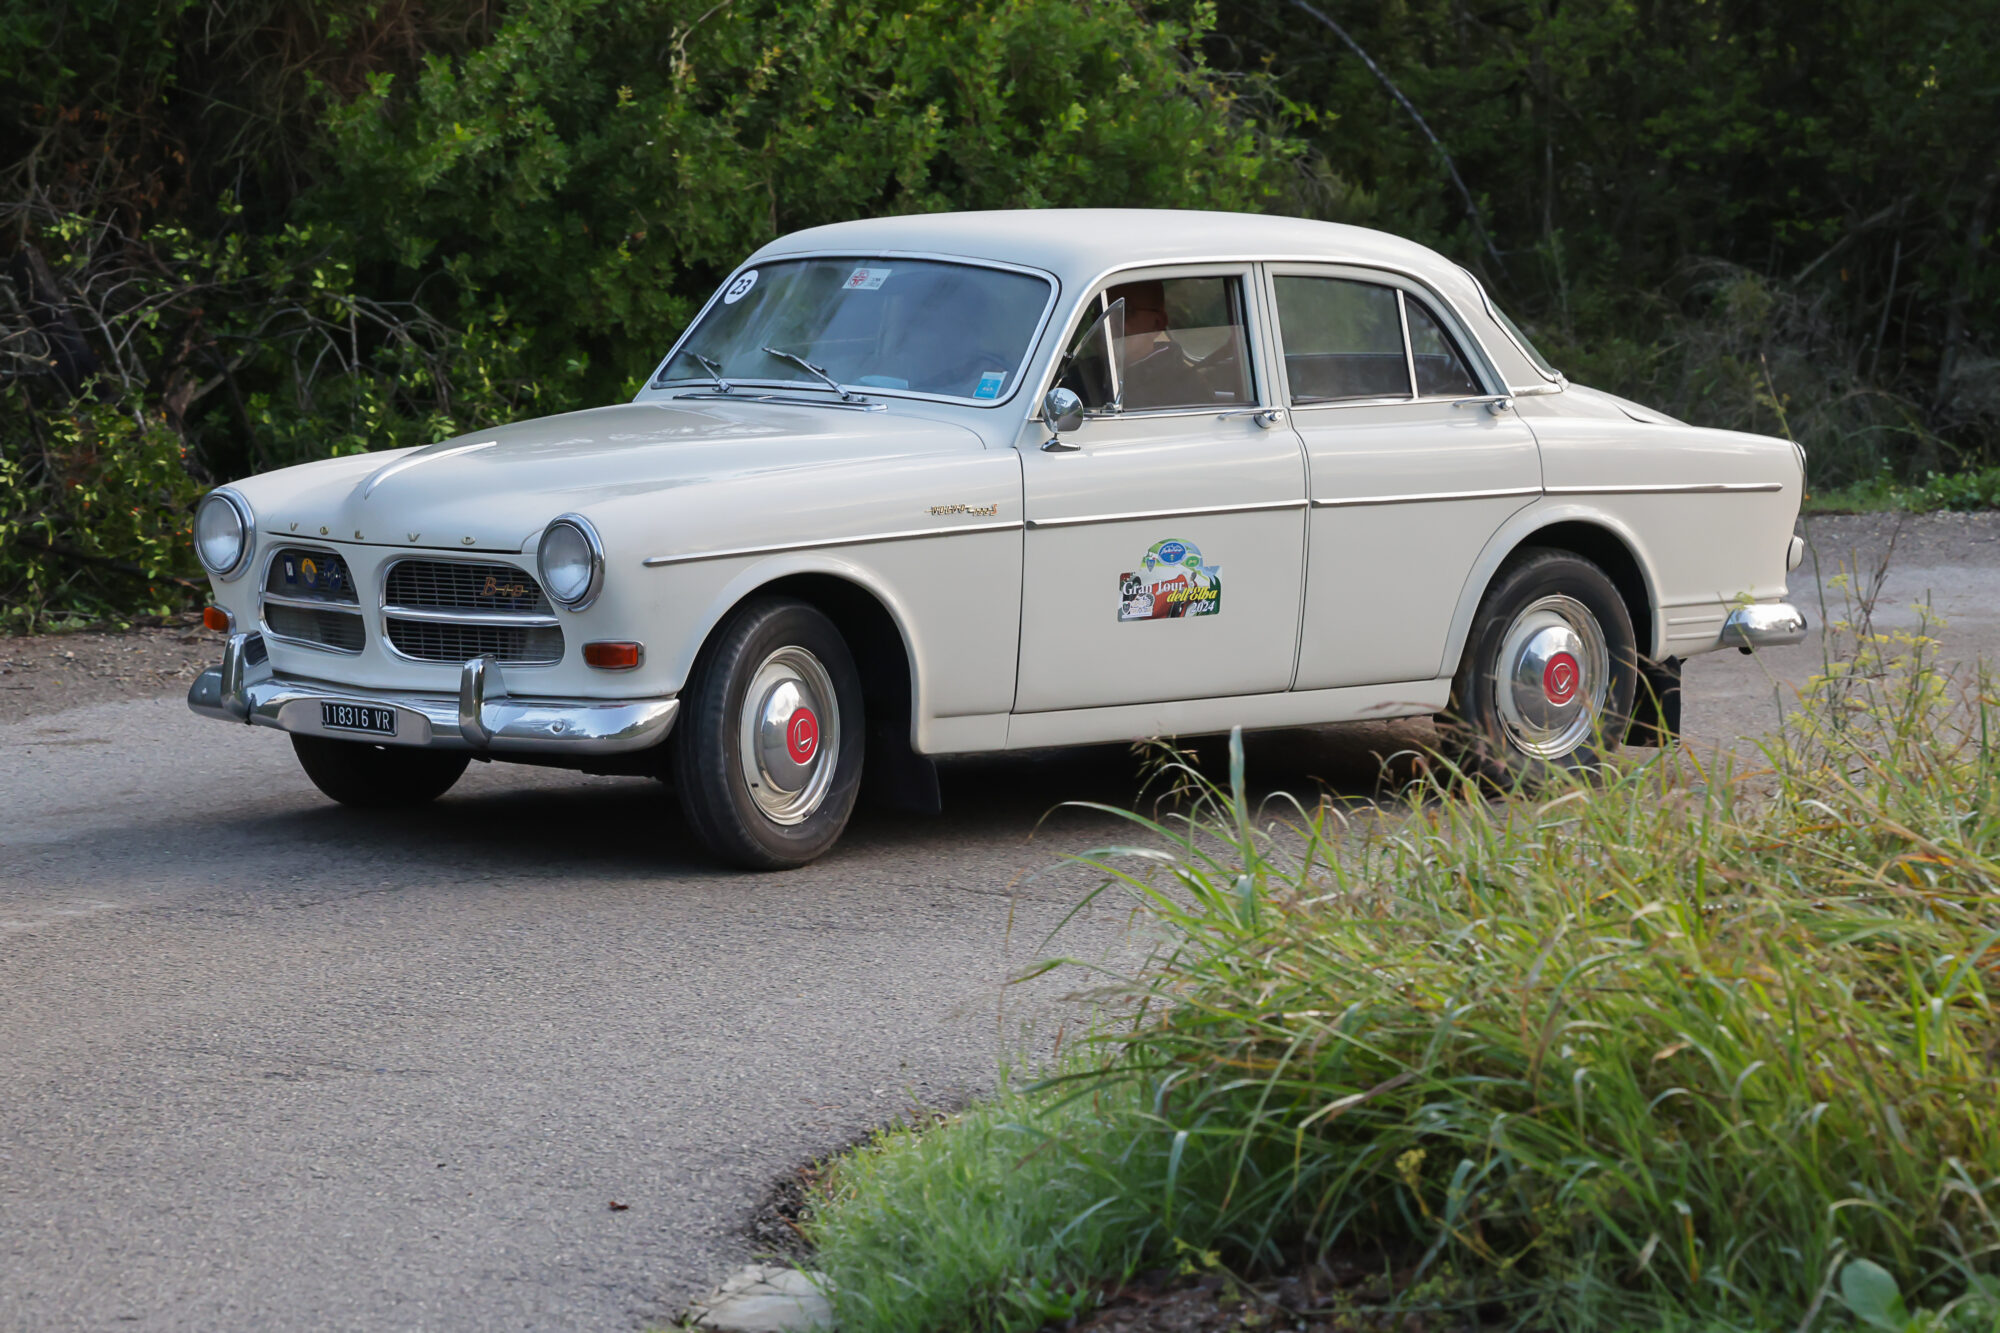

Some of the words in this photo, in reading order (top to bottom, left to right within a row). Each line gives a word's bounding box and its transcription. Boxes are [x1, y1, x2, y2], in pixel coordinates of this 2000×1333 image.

[730, 278, 752, 296] 23
[290, 521, 475, 545] VOLVO
[1122, 581, 1153, 596] Gran
[1191, 600, 1216, 614] 2024
[325, 704, 369, 728] 118316
[374, 710, 390, 730] VR
